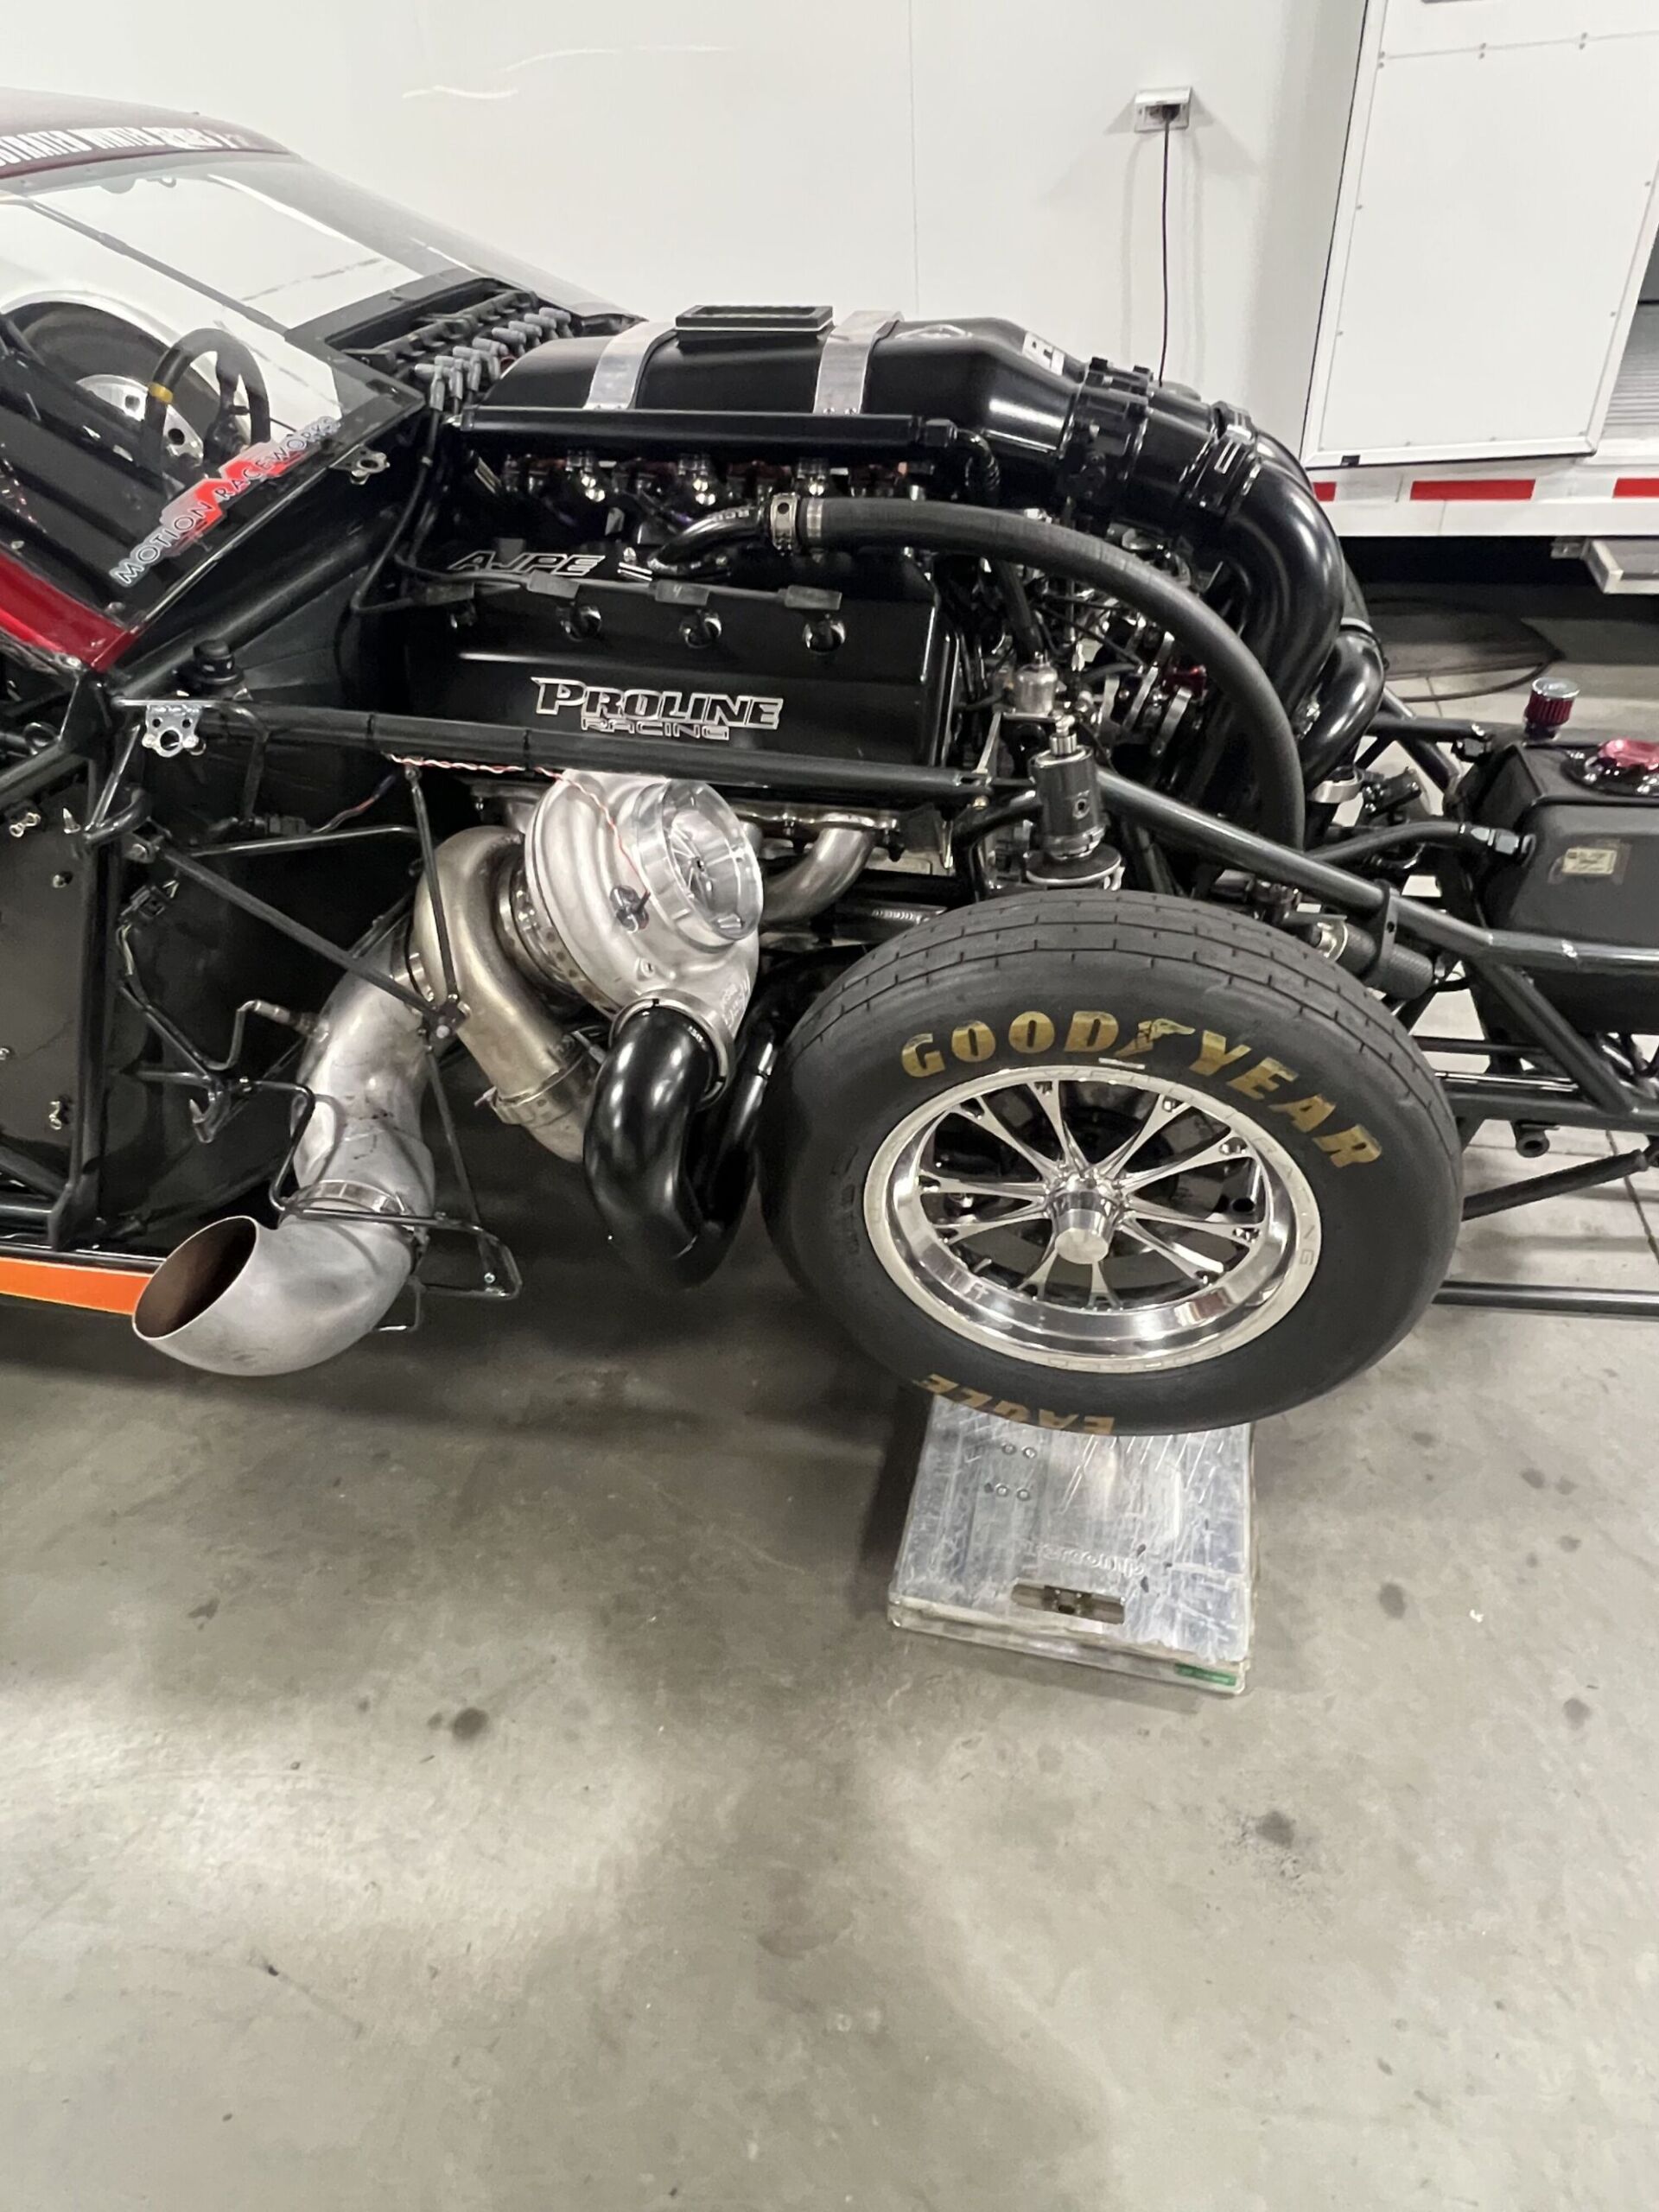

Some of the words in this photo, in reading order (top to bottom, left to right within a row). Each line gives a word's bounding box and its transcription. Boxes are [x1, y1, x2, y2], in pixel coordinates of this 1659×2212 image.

[111, 500, 216, 587] MOTION
[447, 550, 606, 577] AJPE
[530, 677, 784, 730] PROLINE
[580, 715, 730, 741] RACING
[900, 1010, 1384, 1168] GOODYEAR
